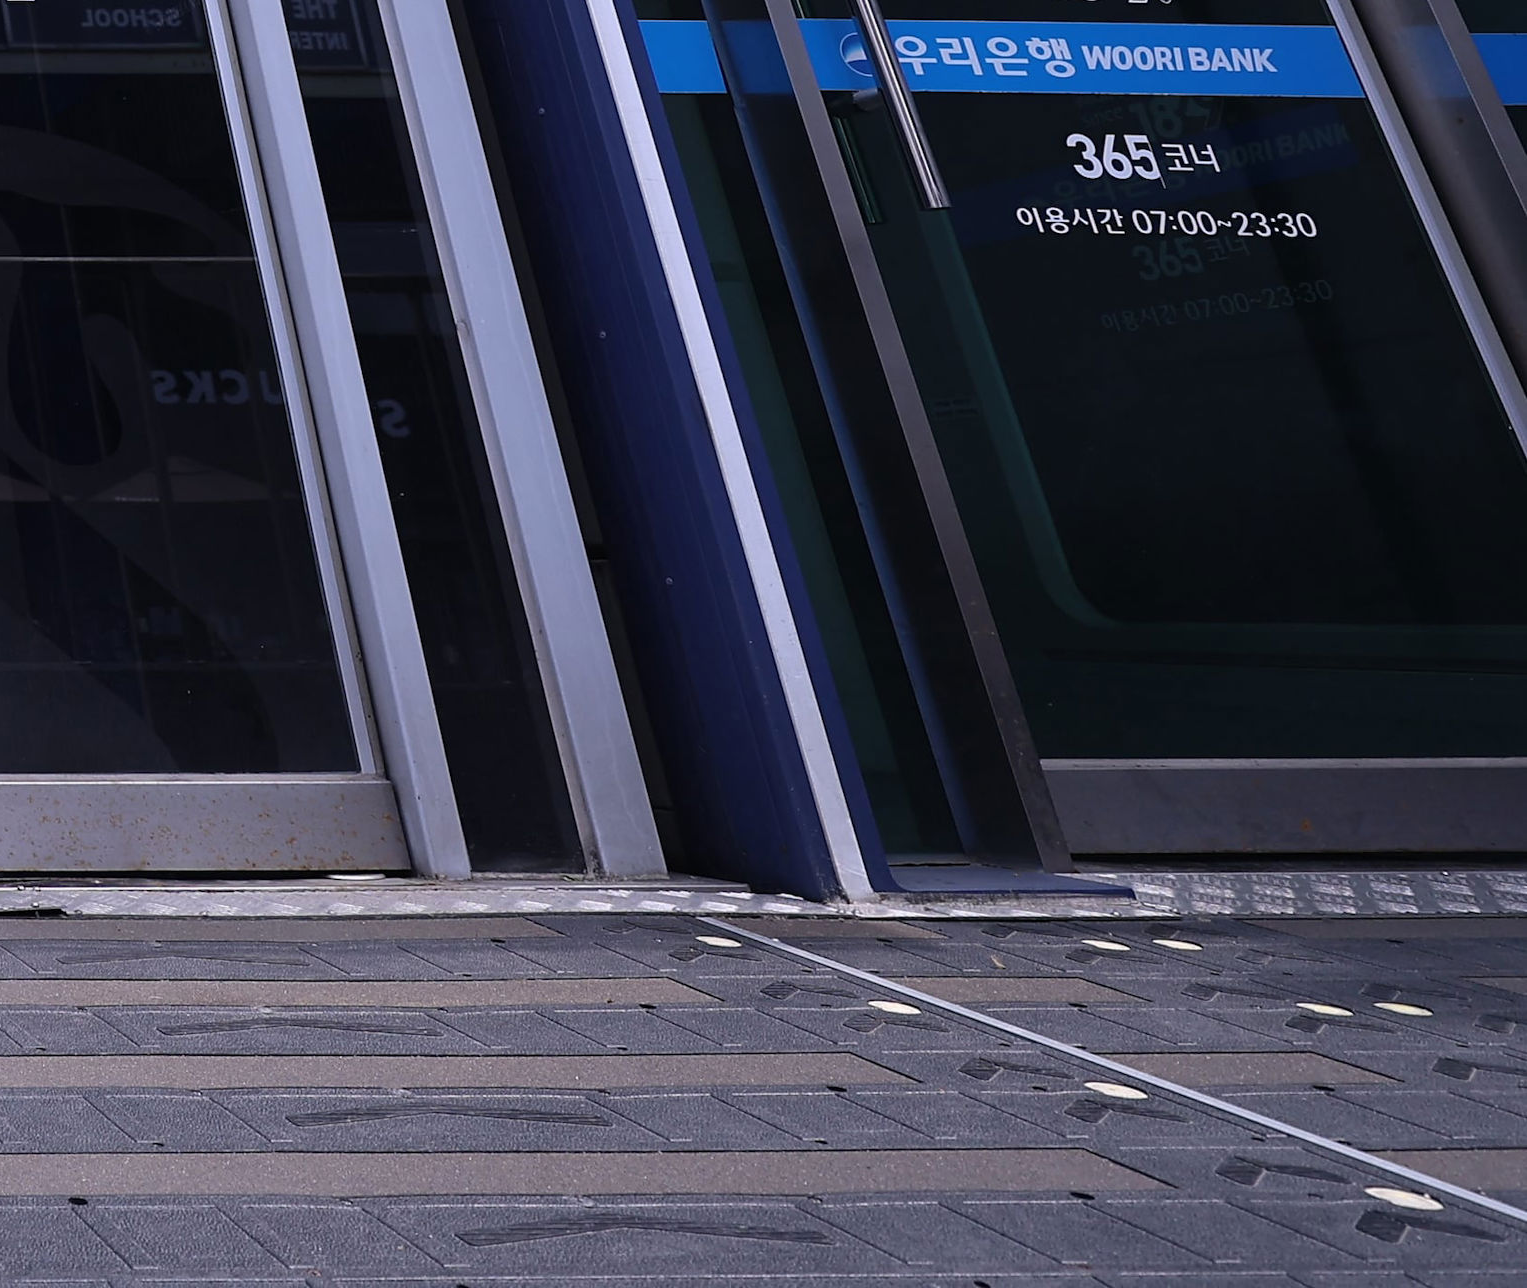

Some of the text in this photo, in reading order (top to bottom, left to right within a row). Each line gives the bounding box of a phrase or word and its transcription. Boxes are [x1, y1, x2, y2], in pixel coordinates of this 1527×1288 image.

[896, 35, 1278, 78] 우리은행 WOORI BANK
[1066, 133, 1221, 181] 365 코너
[1016, 207, 1318, 238] 이용시간 07:00~23:30
